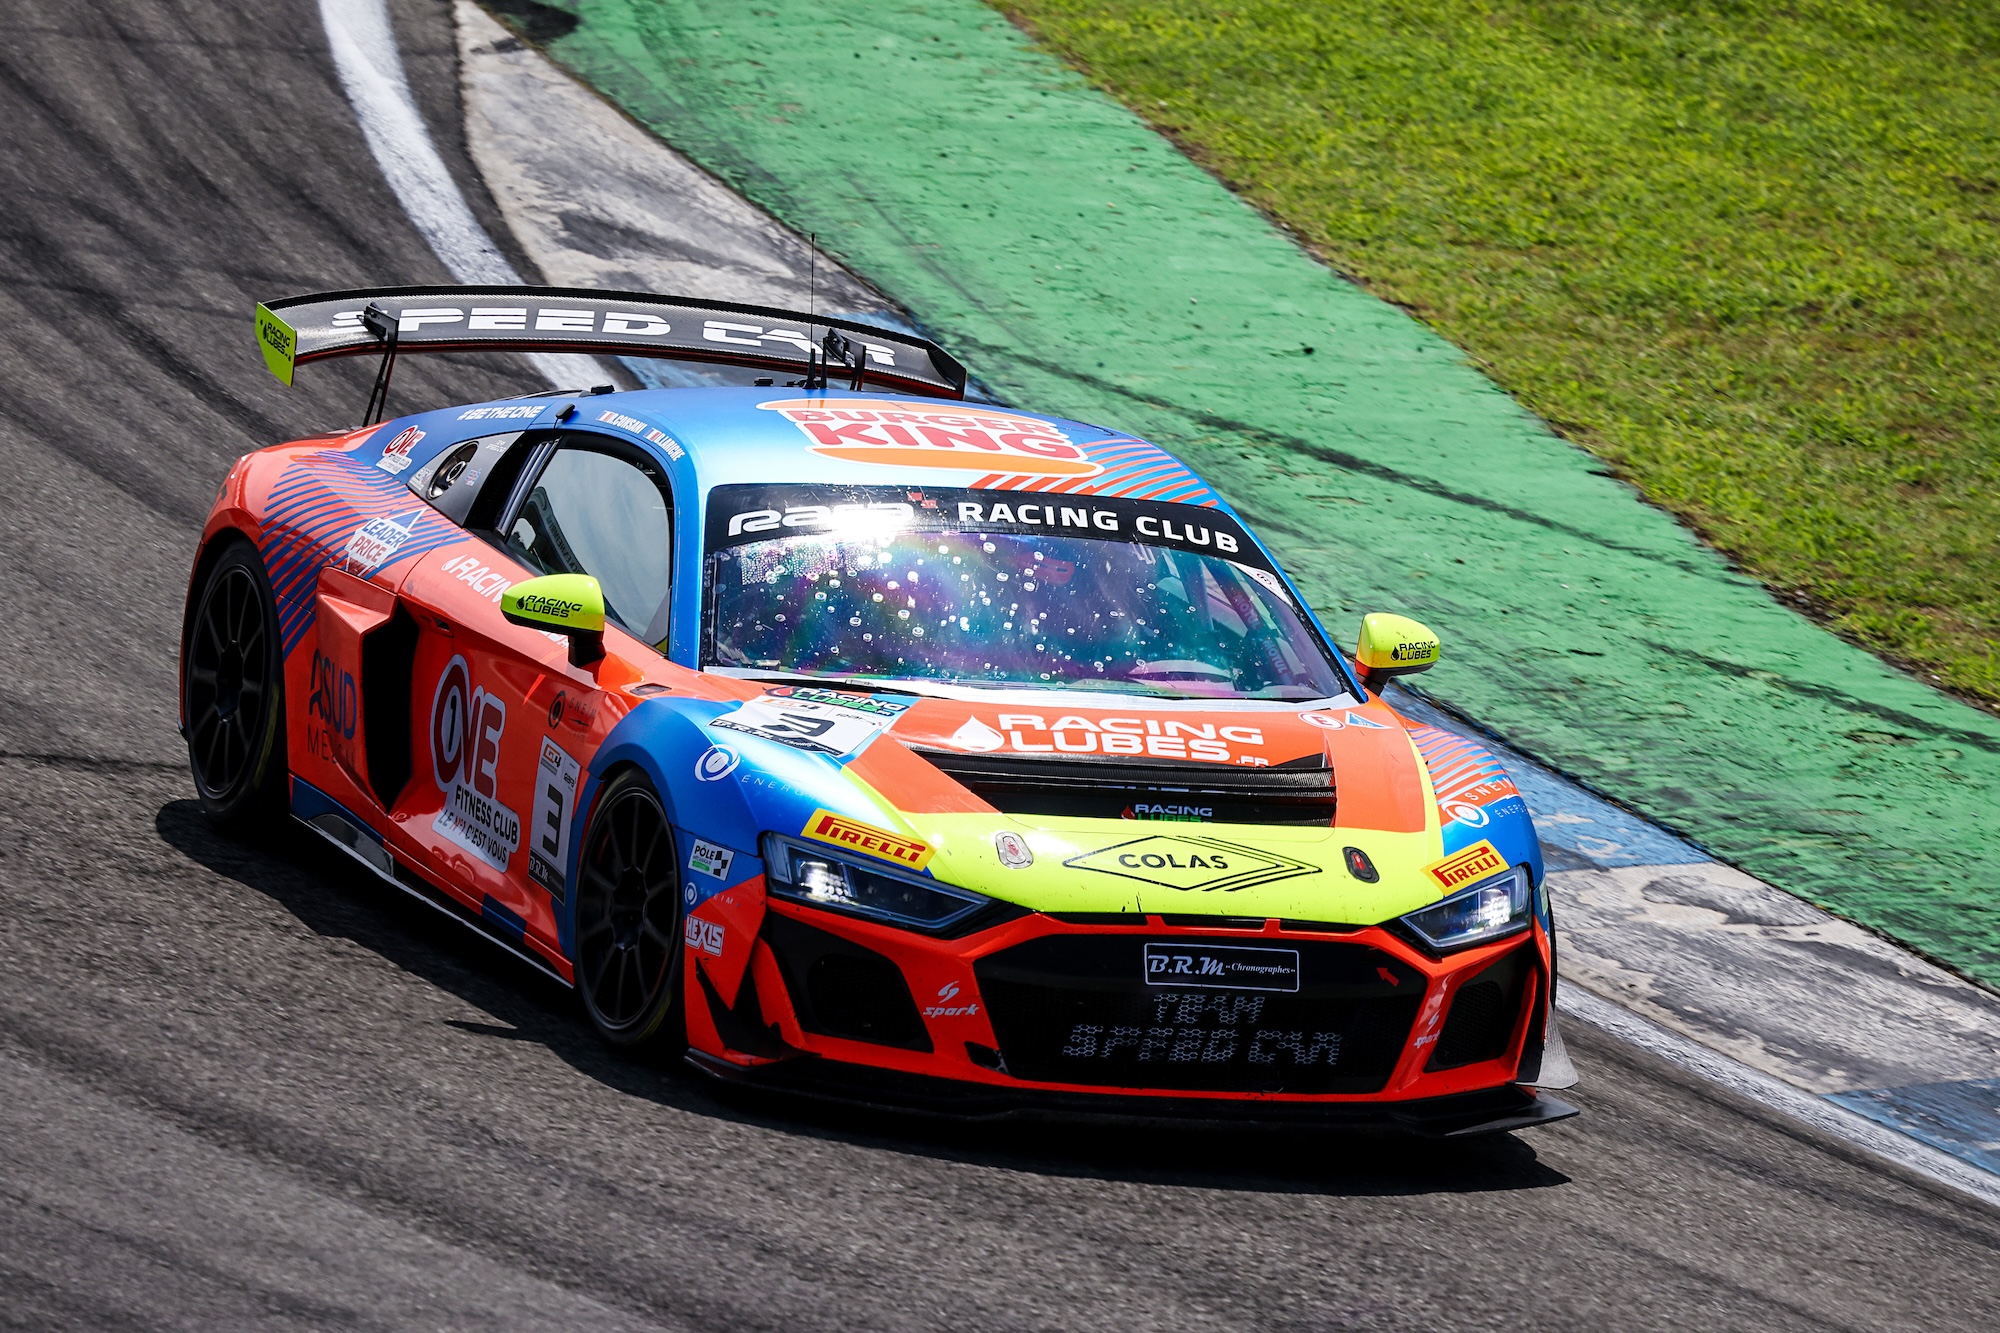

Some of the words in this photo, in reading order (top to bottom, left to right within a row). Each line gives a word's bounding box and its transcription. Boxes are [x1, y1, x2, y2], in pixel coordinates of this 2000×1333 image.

[786, 409, 1052, 436] BURGER
[803, 422, 1082, 460] KING
[361, 518, 408, 548] LEADER
[957, 501, 1119, 532] RACING
[1136, 515, 1239, 553] CLUB
[350, 535, 387, 563] PRICE
[448, 557, 512, 603] RACIN
[524, 602, 570, 618] LUBES
[525, 595, 583, 612] RACING
[1398, 641, 1436, 652] RACING
[1400, 649, 1432, 661] LUBES
[796, 687, 907, 711] RACING
[997, 713, 1265, 745] RACING
[455, 784, 492, 828] FITNESS
[493, 810, 518, 845] CLUB
[542, 783, 564, 859] 3
[1134, 803, 1213, 817] RACING
[487, 837, 508, 864] VOUS
[814, 815, 926, 863] PIRELLI
[1118, 853, 1229, 870] COLAS
[1431, 846, 1501, 888] PIRELLI
[685, 916, 724, 949] HEXIS
[922, 1003, 980, 1019] spark
